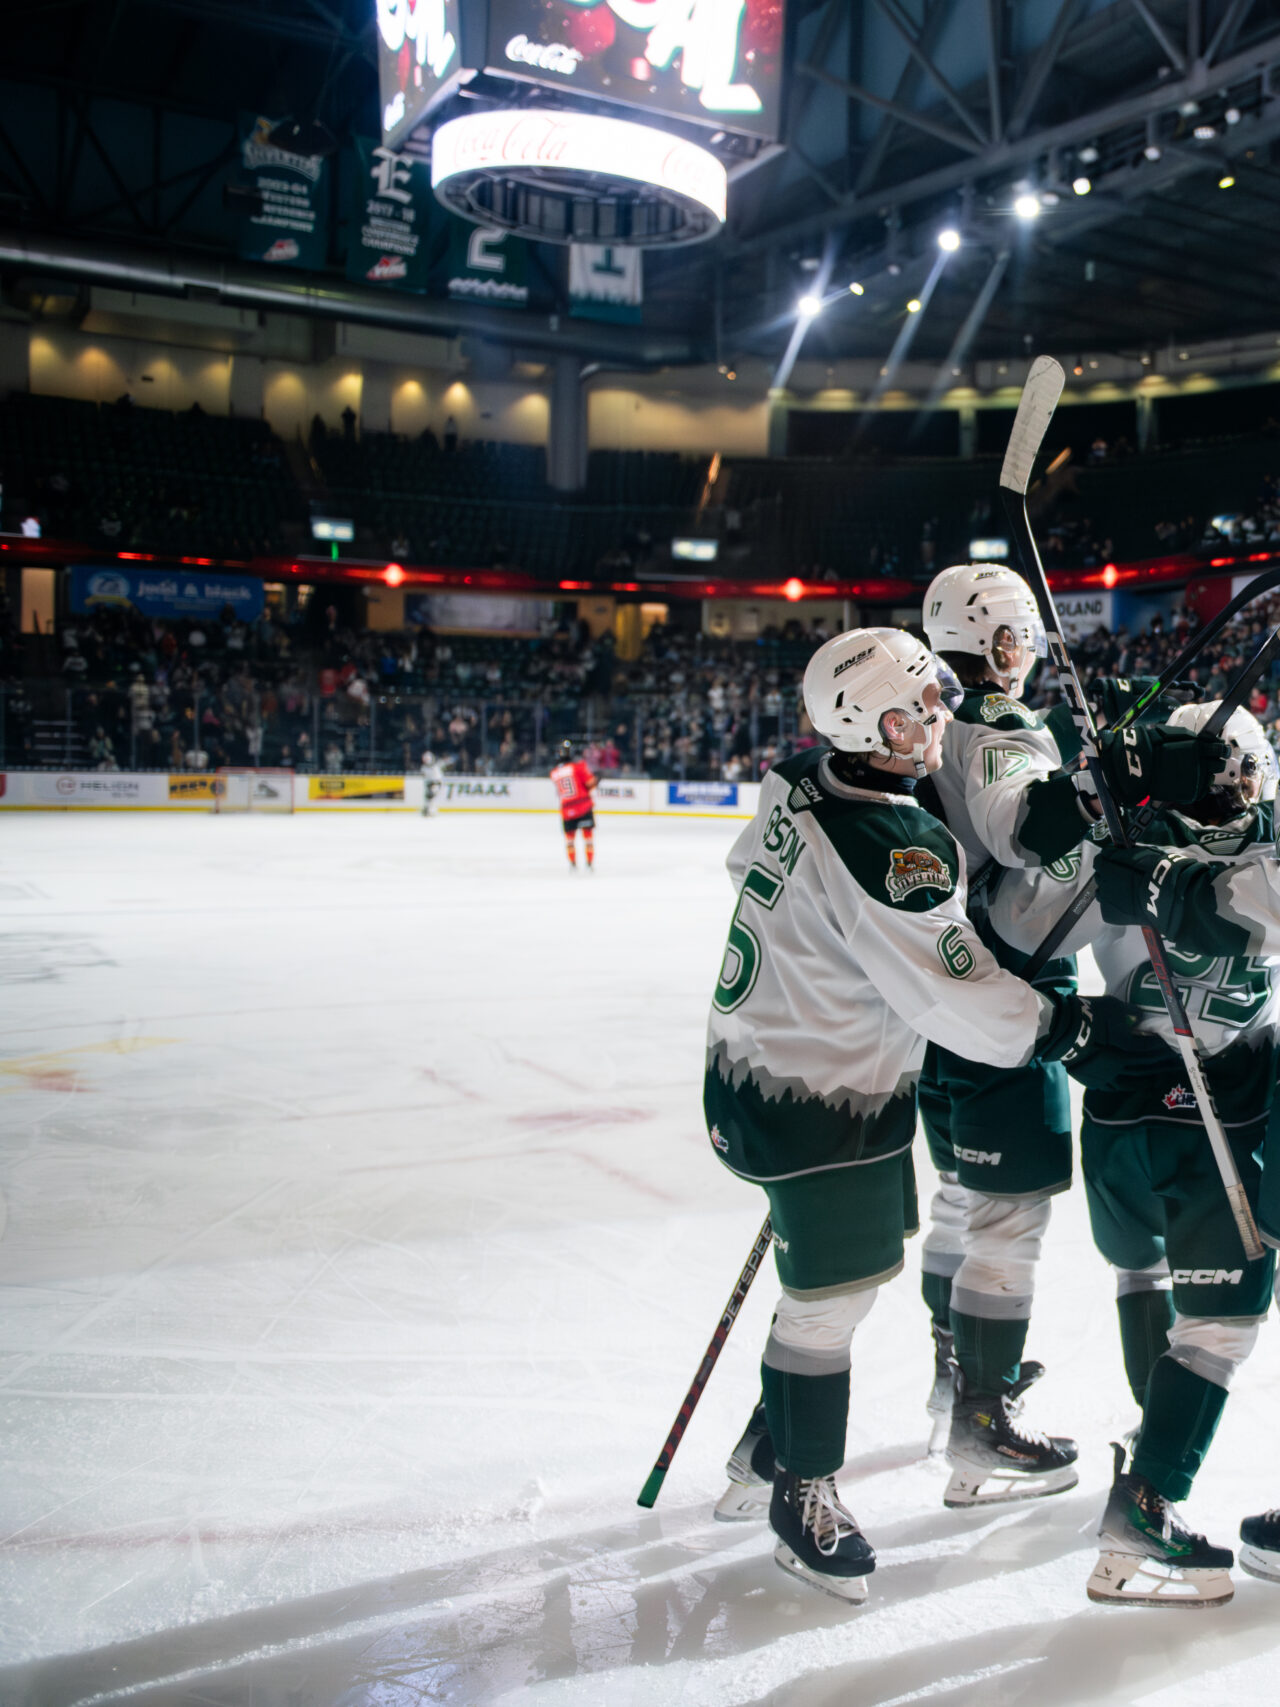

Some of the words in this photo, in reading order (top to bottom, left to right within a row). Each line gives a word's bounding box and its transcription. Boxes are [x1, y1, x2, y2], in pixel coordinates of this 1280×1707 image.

[931, 601, 942, 617] 17
[833, 645, 877, 678] BNSF
[1047, 631, 1099, 757] CCM
[983, 747, 1032, 789] 17
[800, 777, 824, 803] CCM
[936, 923, 977, 980] 6
[953, 1143, 1002, 1166] CCM
[723, 1216, 774, 1332] JETSPEE
[1172, 1269, 1244, 1285] CCM
